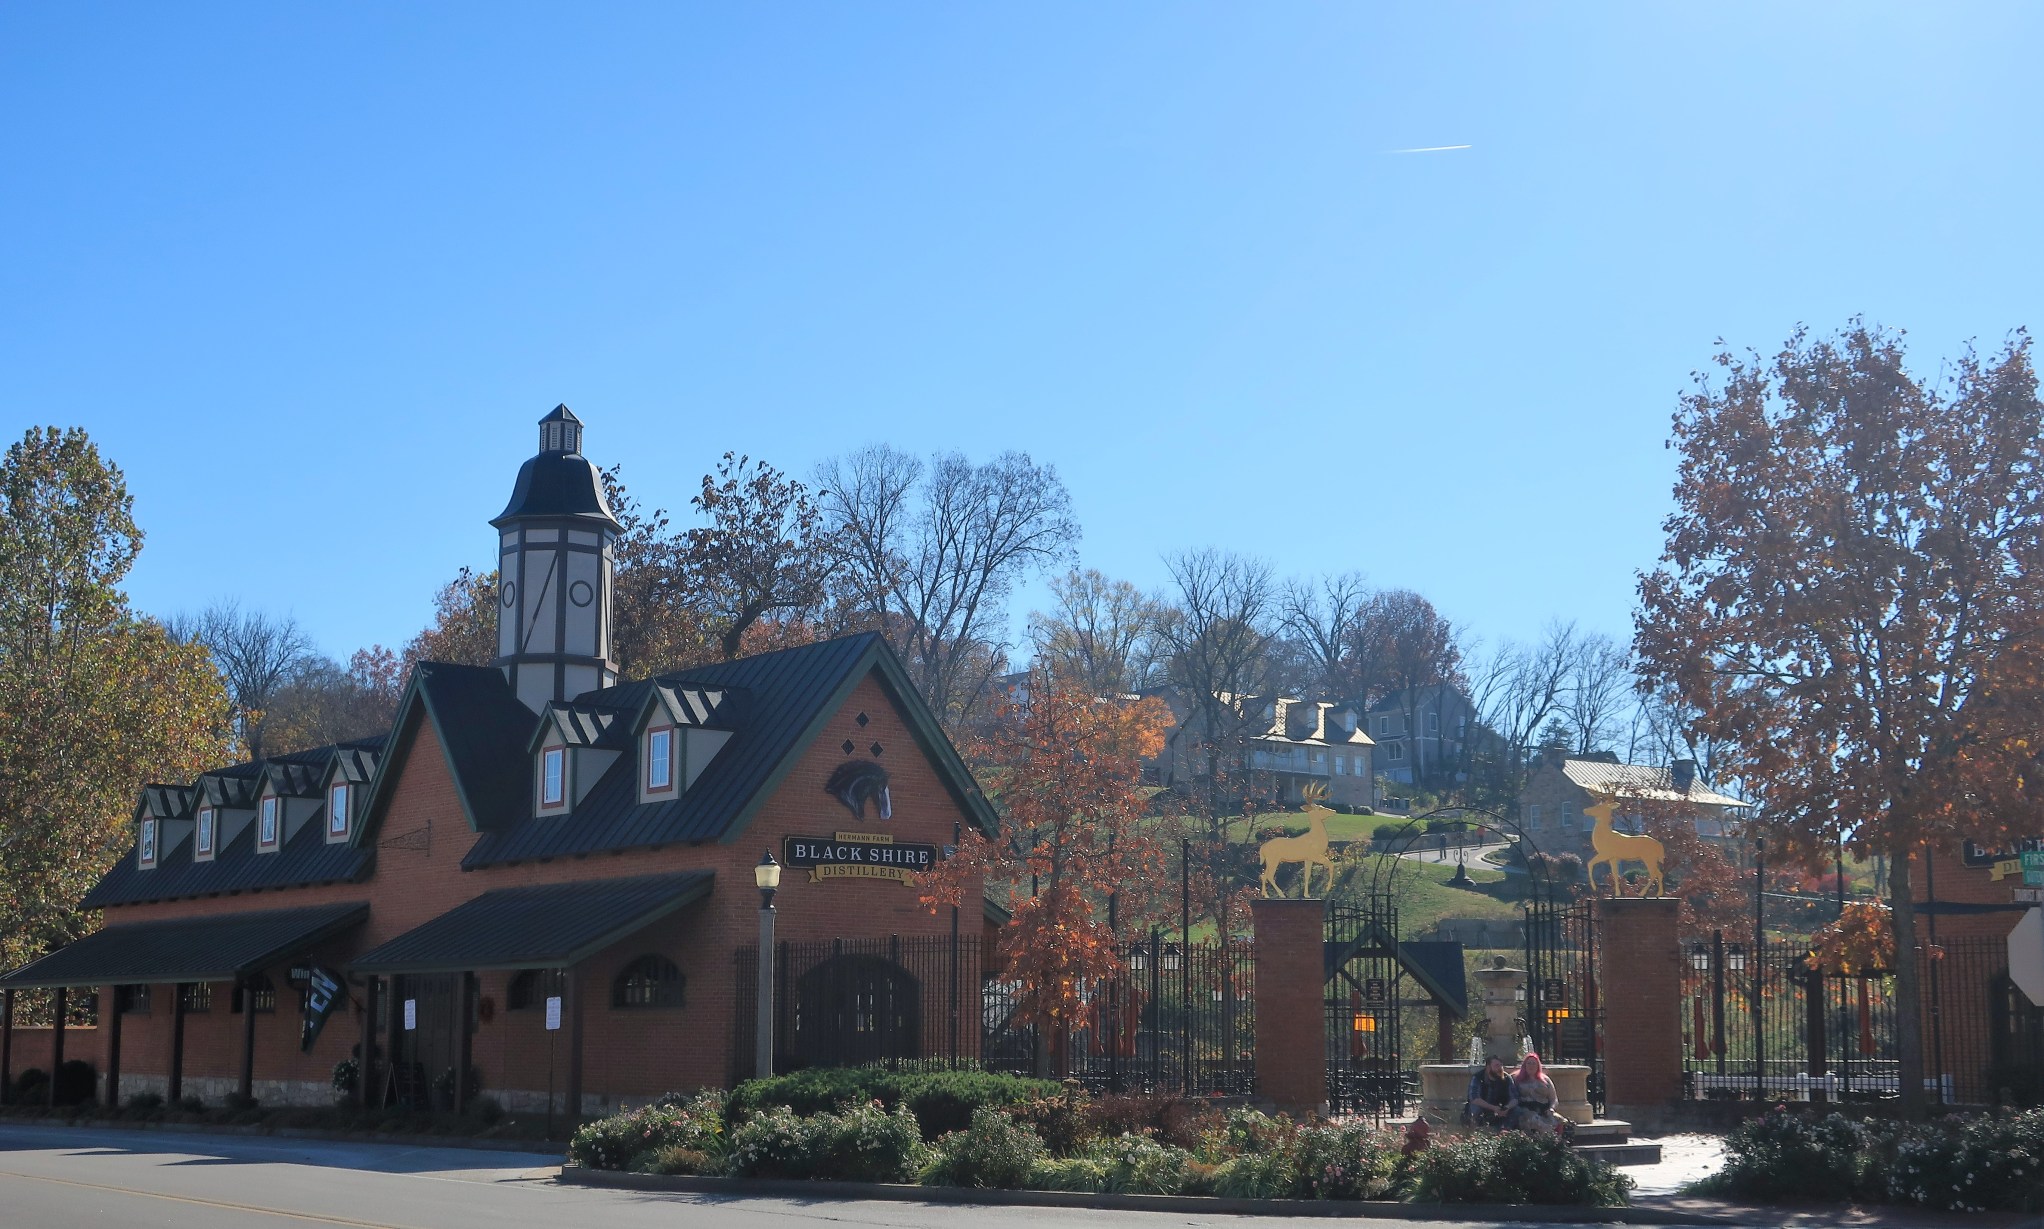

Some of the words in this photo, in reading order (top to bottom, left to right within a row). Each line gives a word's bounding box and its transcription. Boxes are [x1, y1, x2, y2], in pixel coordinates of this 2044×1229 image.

[795, 844, 862, 861] BLACK
[869, 848, 929, 864] SHIRE
[823, 866, 905, 879] DISTILLERY
